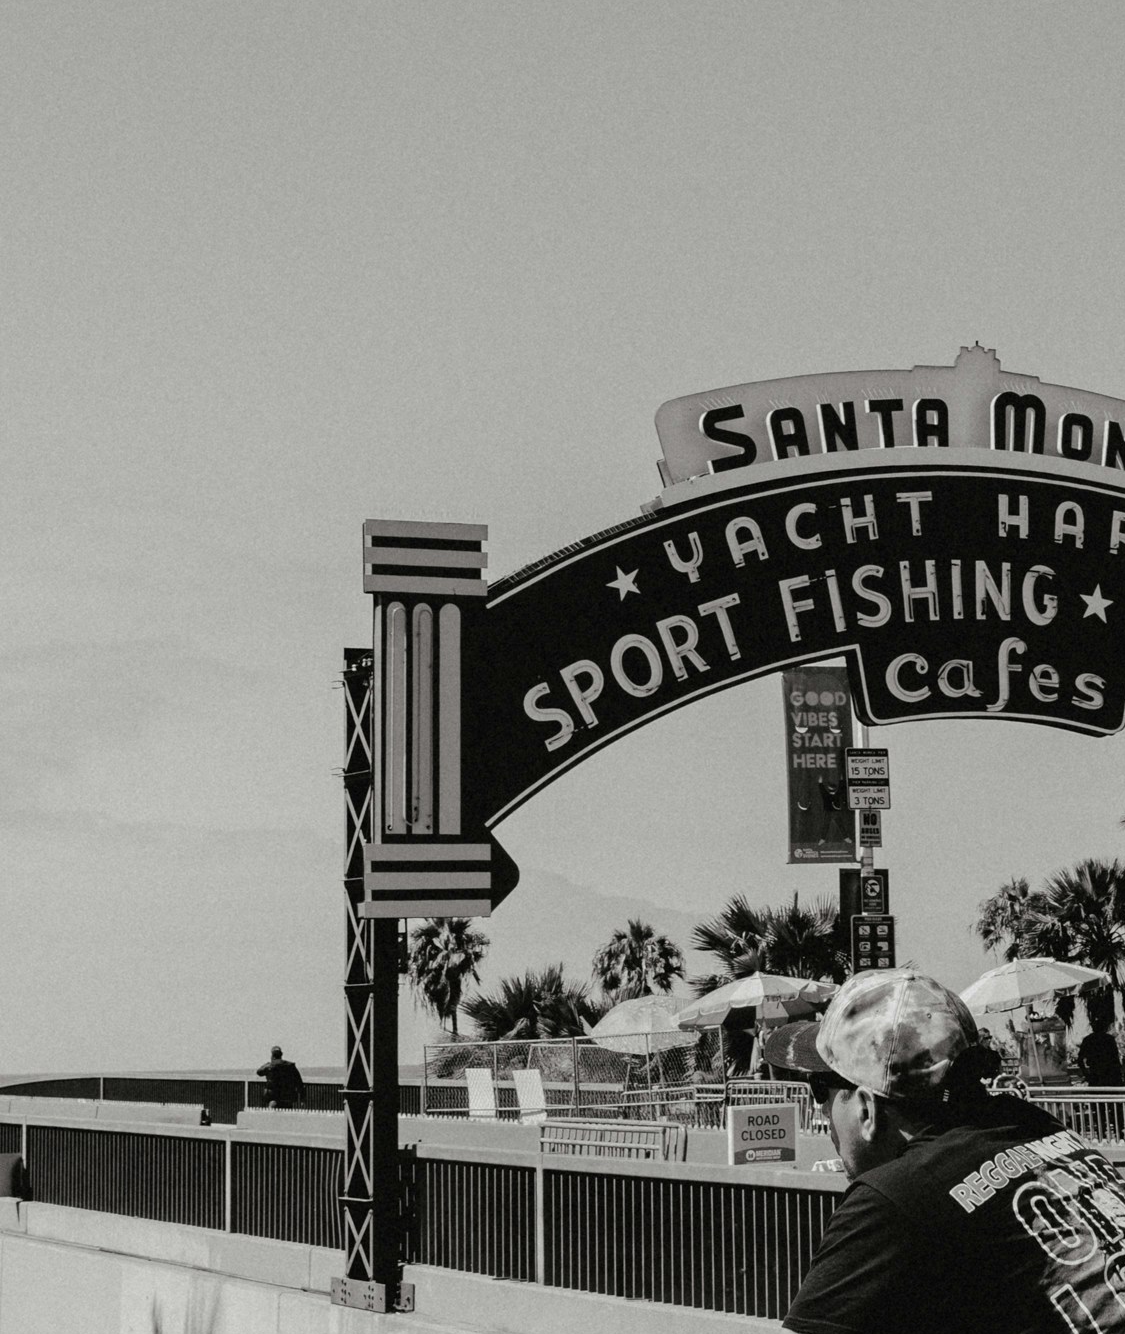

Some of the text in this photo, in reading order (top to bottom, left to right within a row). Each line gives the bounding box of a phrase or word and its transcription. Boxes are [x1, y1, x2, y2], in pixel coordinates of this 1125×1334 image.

[699, 396, 949, 475] SANTA
[663, 491, 933, 584] YACHT
[522, 592, 742, 752] SPORT
[778, 560, 1059, 642] FISHING
[789, 691, 847, 707] GOOD
[791, 711, 838, 727] VIBES
[792, 733, 842, 748] START
[793, 753, 837, 768] HERE
[851, 766, 885, 776] 15 TONS
[854, 796, 885, 805] 3 TONS
[863, 813, 878, 826] NO
[747, 1114, 780, 1127] ROAD
[741, 1128, 786, 1142] CLOSED
[949, 1145, 1044, 1213] REGGAE
